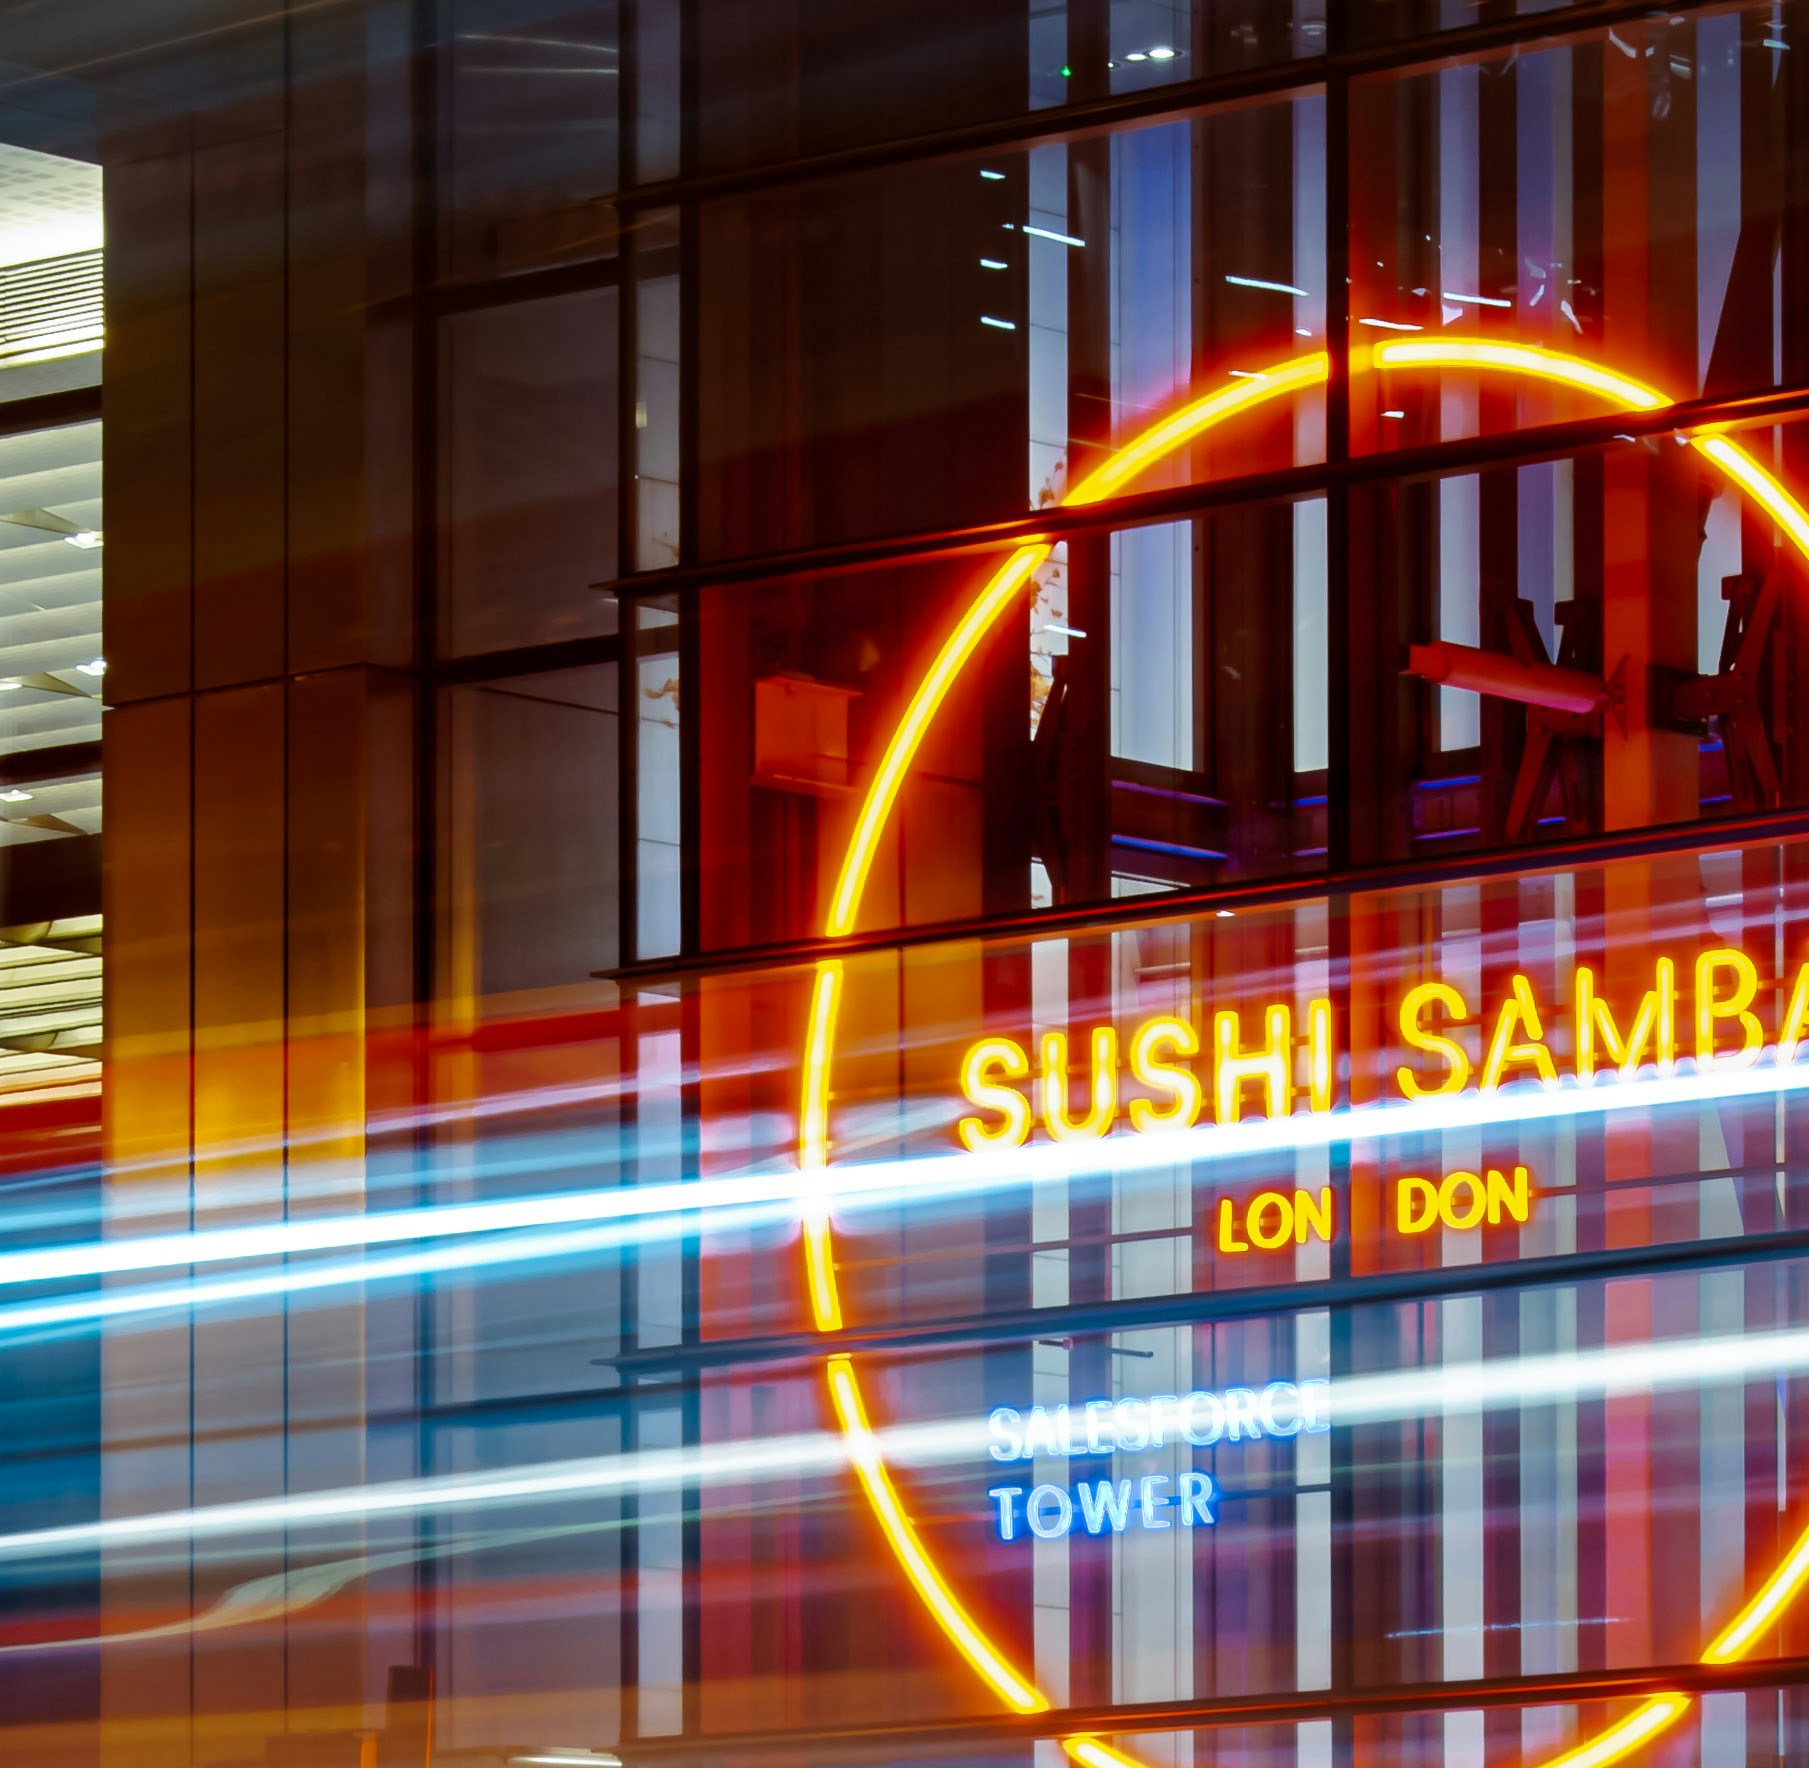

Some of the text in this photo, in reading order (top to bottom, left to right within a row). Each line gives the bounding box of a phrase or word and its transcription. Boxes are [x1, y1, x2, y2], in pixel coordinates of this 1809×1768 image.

[959, 998, 1332, 1153] SUSHI
[988, 1379, 1332, 1462] SALESFORCE
[989, 1472, 1215, 1541] TOWER
